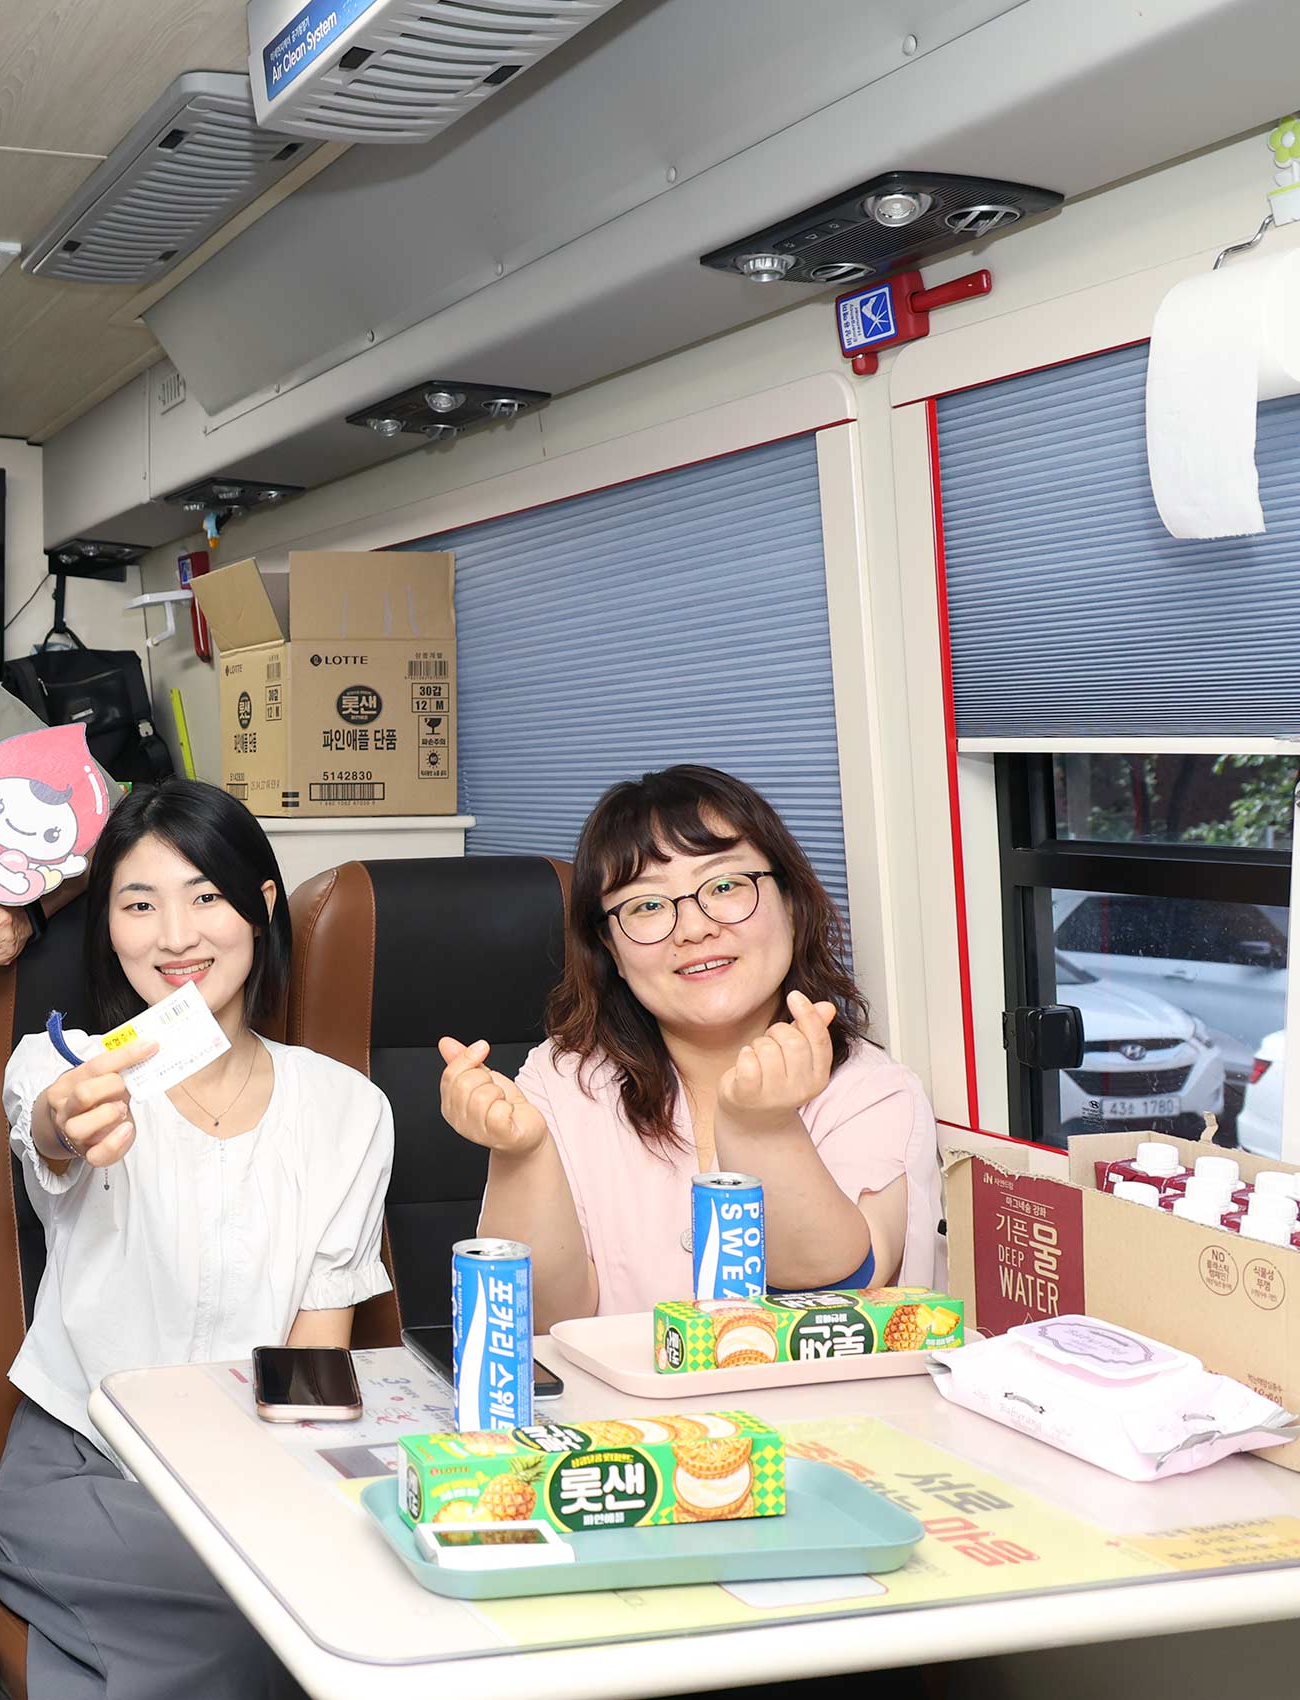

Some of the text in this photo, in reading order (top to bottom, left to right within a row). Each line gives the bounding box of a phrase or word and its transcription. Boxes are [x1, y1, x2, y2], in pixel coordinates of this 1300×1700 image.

[272, 11, 338, 85] Air Clean System
[325, 655, 369, 665] LOTTE
[229, 664, 243, 674] LOTTE
[419, 686, 442, 697] 30갑
[341, 695, 378, 715] 롯샌
[415, 700, 428, 711] 12
[435, 700, 444, 711] M
[322, 729, 398, 751] 파인애플 단품
[323, 771, 373, 781] 5142830
[1142, 1100, 1174, 1115] 1780
[1005, 1196, 1032, 1213] 마그네슘
[998, 1244, 1025, 1268] DEEP
[1211, 1249, 1225, 1262] NO
[1253, 1265, 1274, 1281] 식물성
[999, 1264, 1060, 1317] WATER
[488, 1276, 516, 1358] 포카리
[559, 1462, 646, 1515] 롯샌
[893, 1472, 1015, 1515] 서로
[582, 1512, 626, 1526] 파인애플
